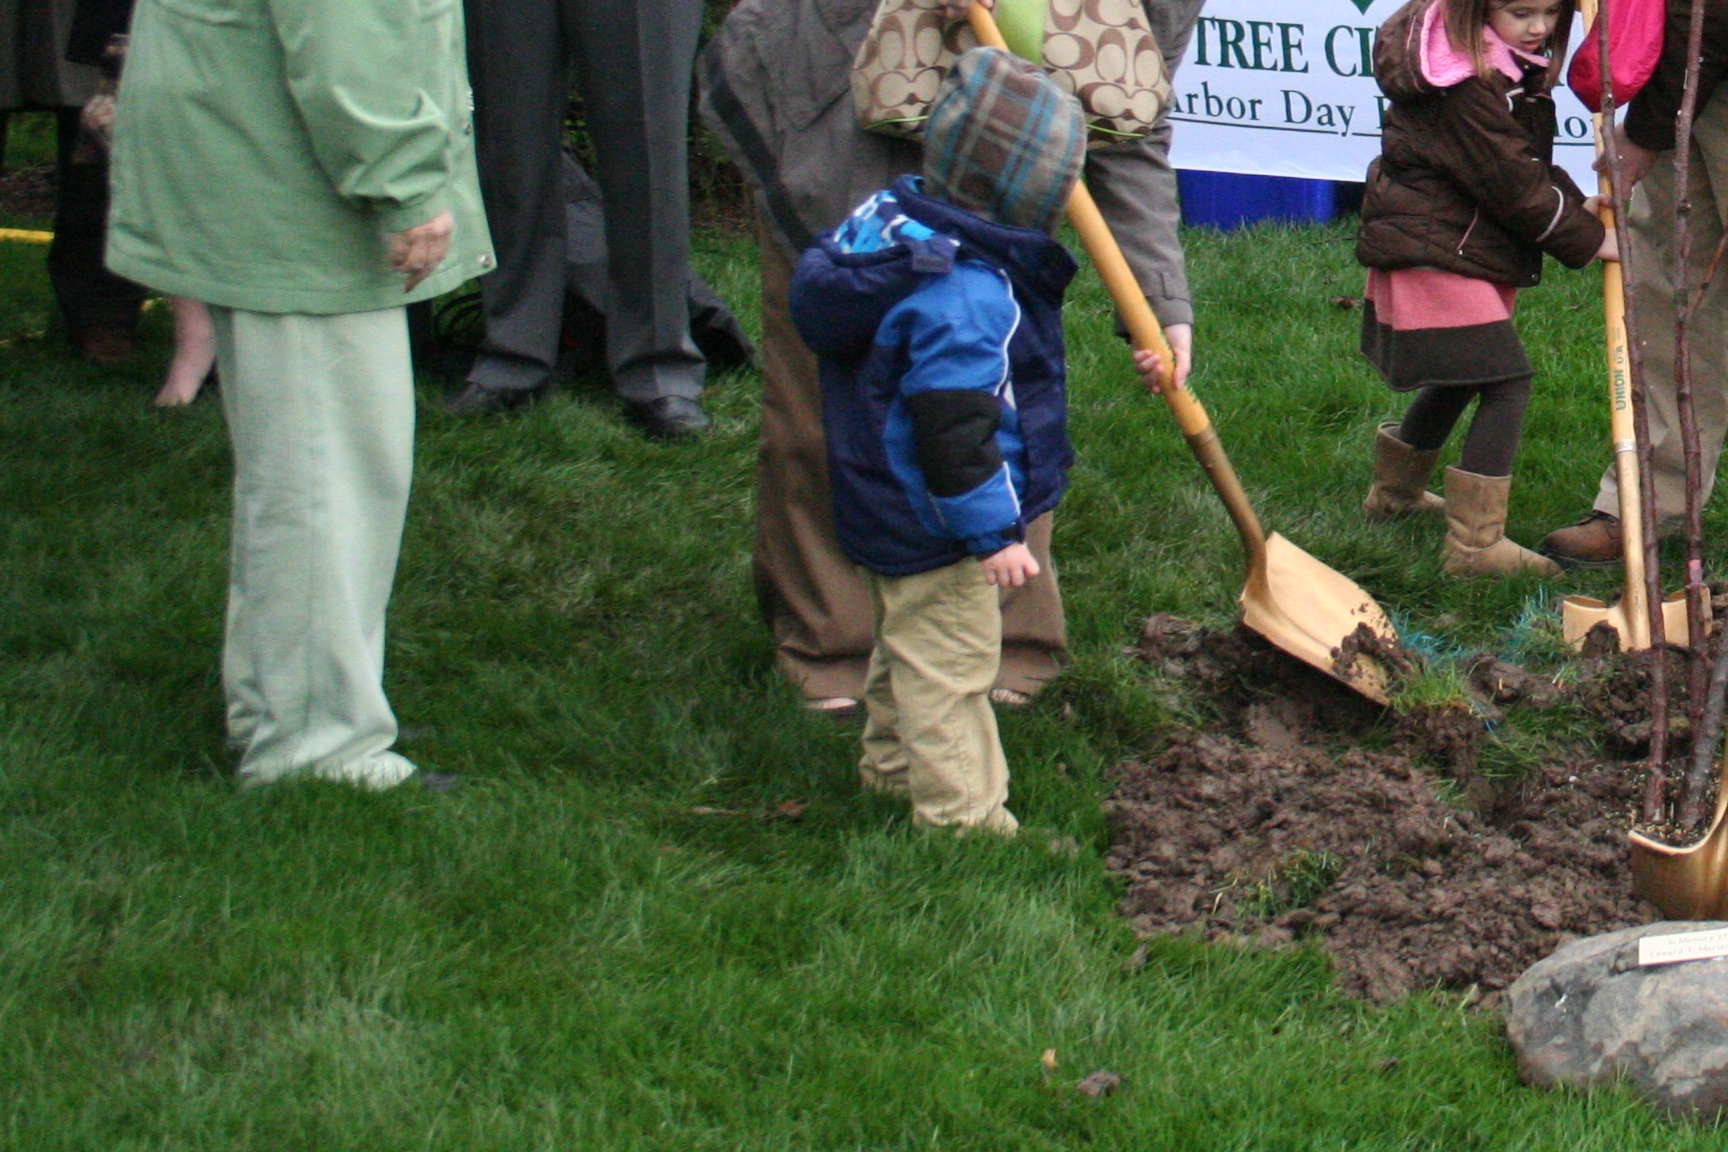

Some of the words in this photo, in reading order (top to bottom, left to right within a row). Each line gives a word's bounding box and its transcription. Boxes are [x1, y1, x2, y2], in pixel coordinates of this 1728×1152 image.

[1194, 16, 1309, 74] TREE
[1324, 24, 1376, 78] CI
[1280, 89, 1356, 138] Day
[1613, 370, 1627, 411] UNION
[1649, 946, 1684, 958] Edward
[1678, 934, 1714, 945] Memory
[1718, 931, 1728, 940] of
